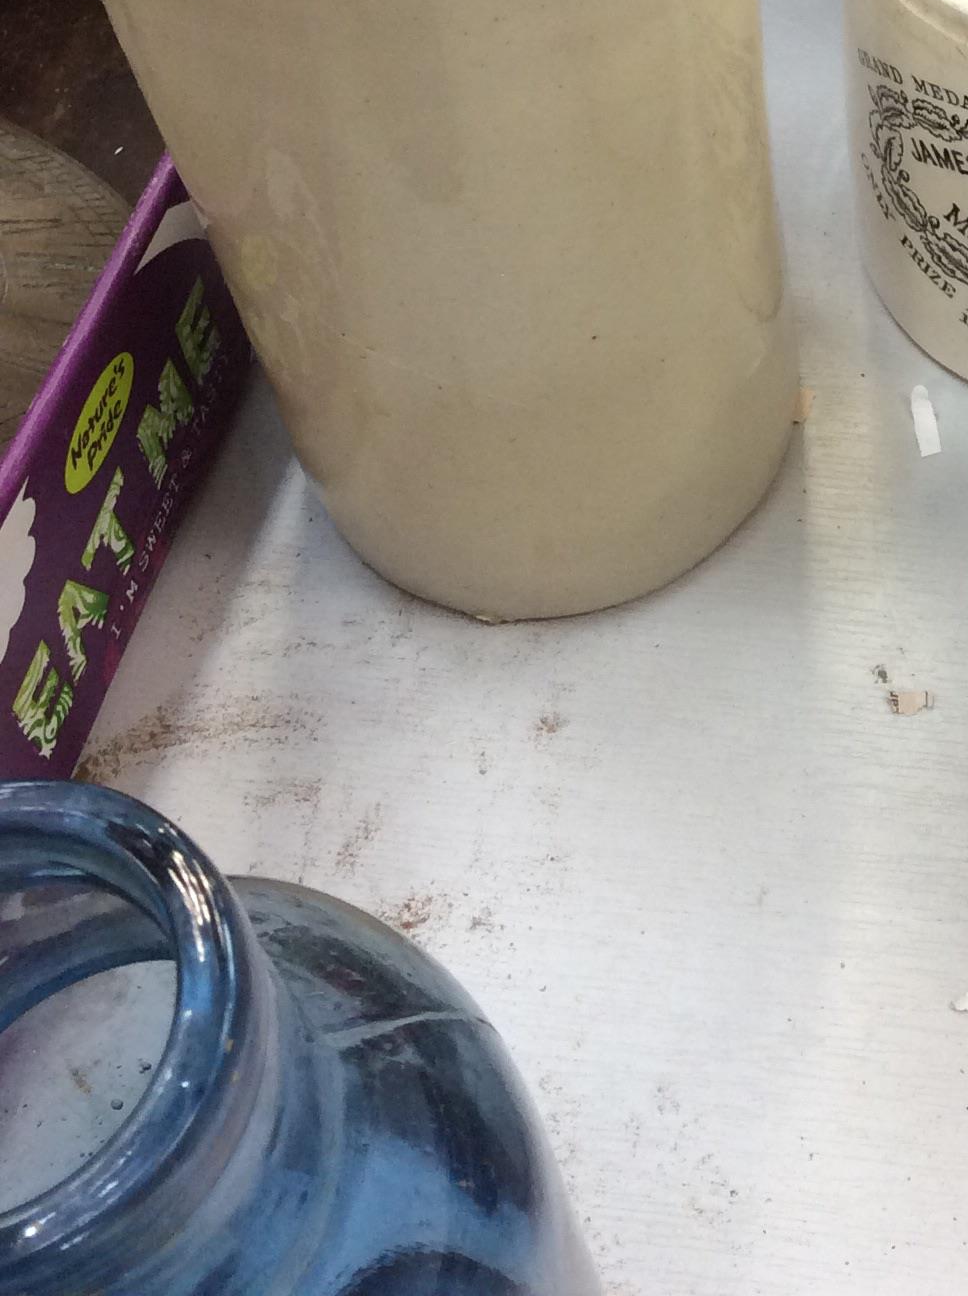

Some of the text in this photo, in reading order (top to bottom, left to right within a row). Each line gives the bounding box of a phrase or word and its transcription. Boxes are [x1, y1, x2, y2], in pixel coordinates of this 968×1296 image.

[900, 234, 957, 298] PRIZE
[88, 400, 122, 471] Pride
[12, 274, 222, 760] EAT ME
[138, 473, 181, 573] SWEET
